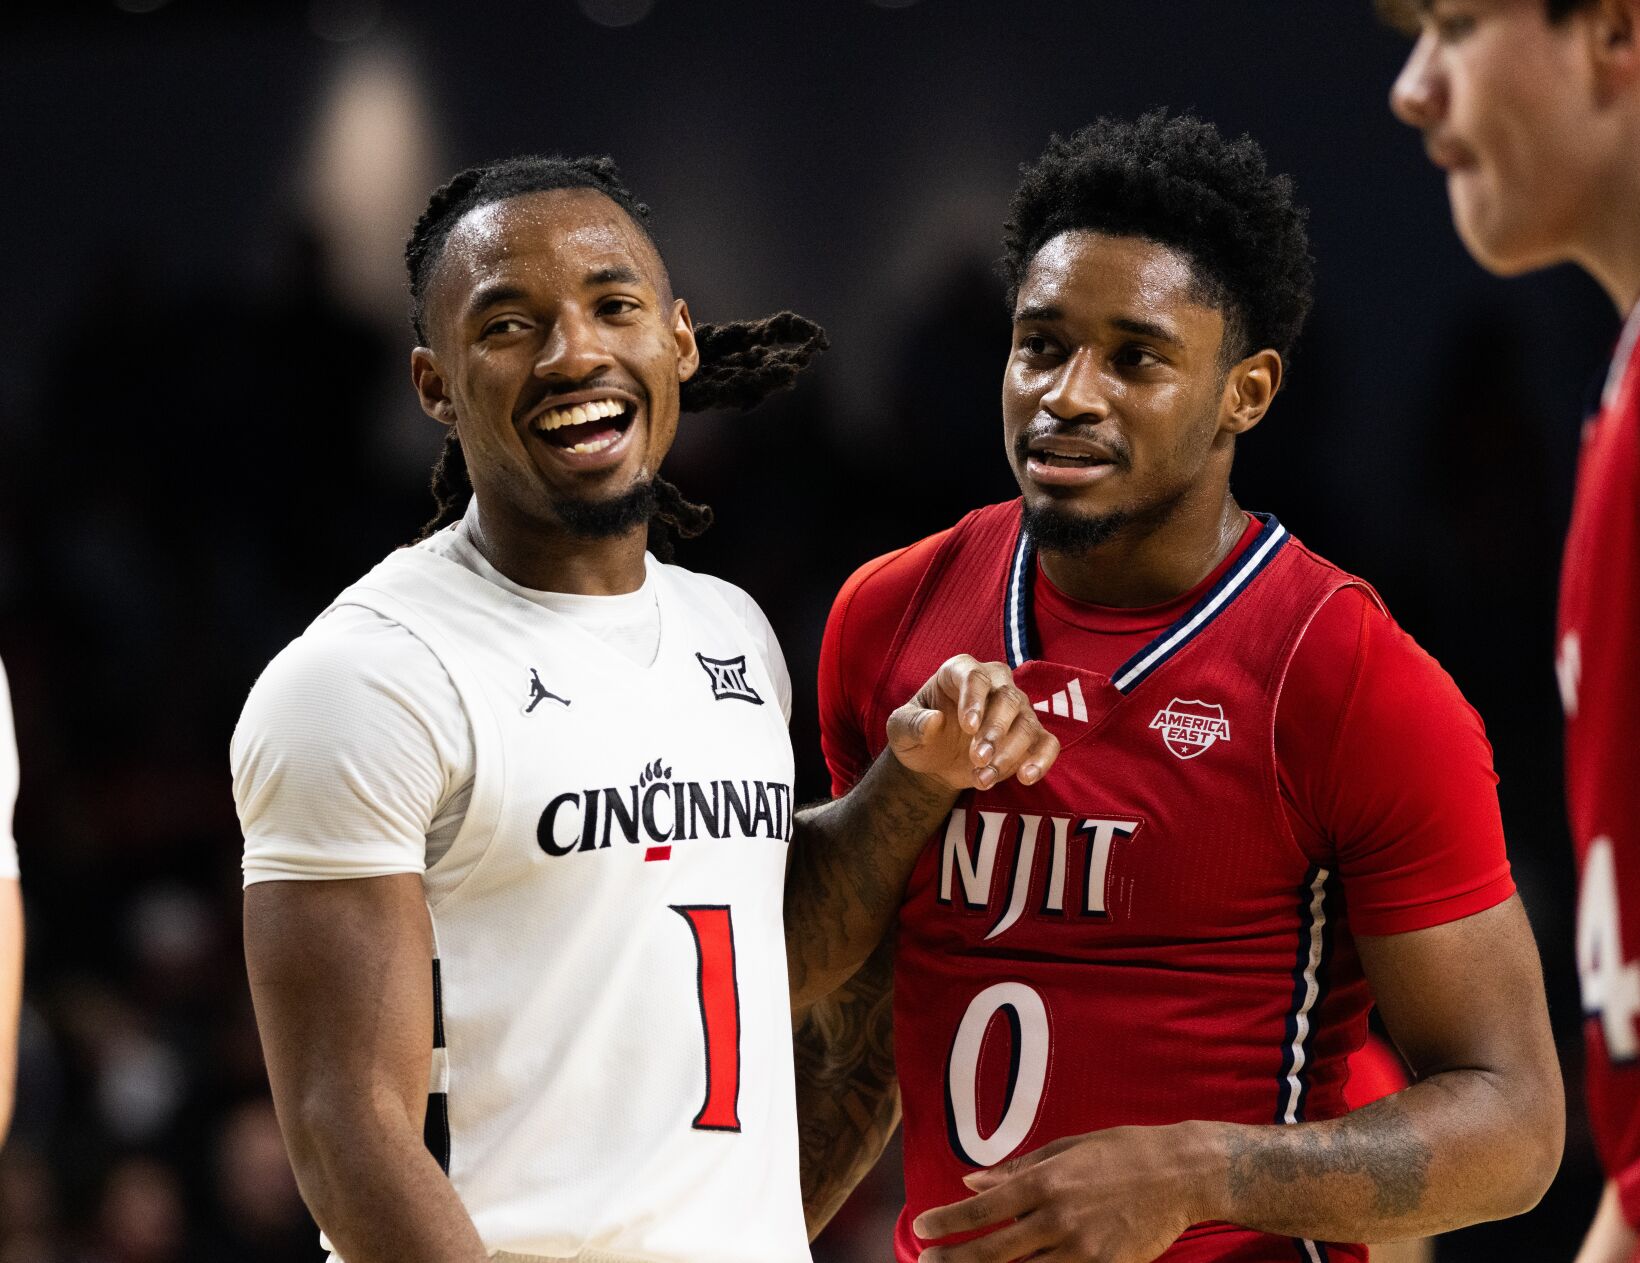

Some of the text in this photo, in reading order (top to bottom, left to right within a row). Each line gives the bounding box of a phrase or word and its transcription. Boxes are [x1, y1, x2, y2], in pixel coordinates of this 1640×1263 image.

[1153, 712, 1228, 738] AMERICA
[1167, 727, 1211, 744] EAST
[536, 779, 791, 857] CINCINNATI
[937, 807, 1140, 941] NJIT
[667, 904, 741, 1133] 1
[943, 981, 1050, 1168] 0
